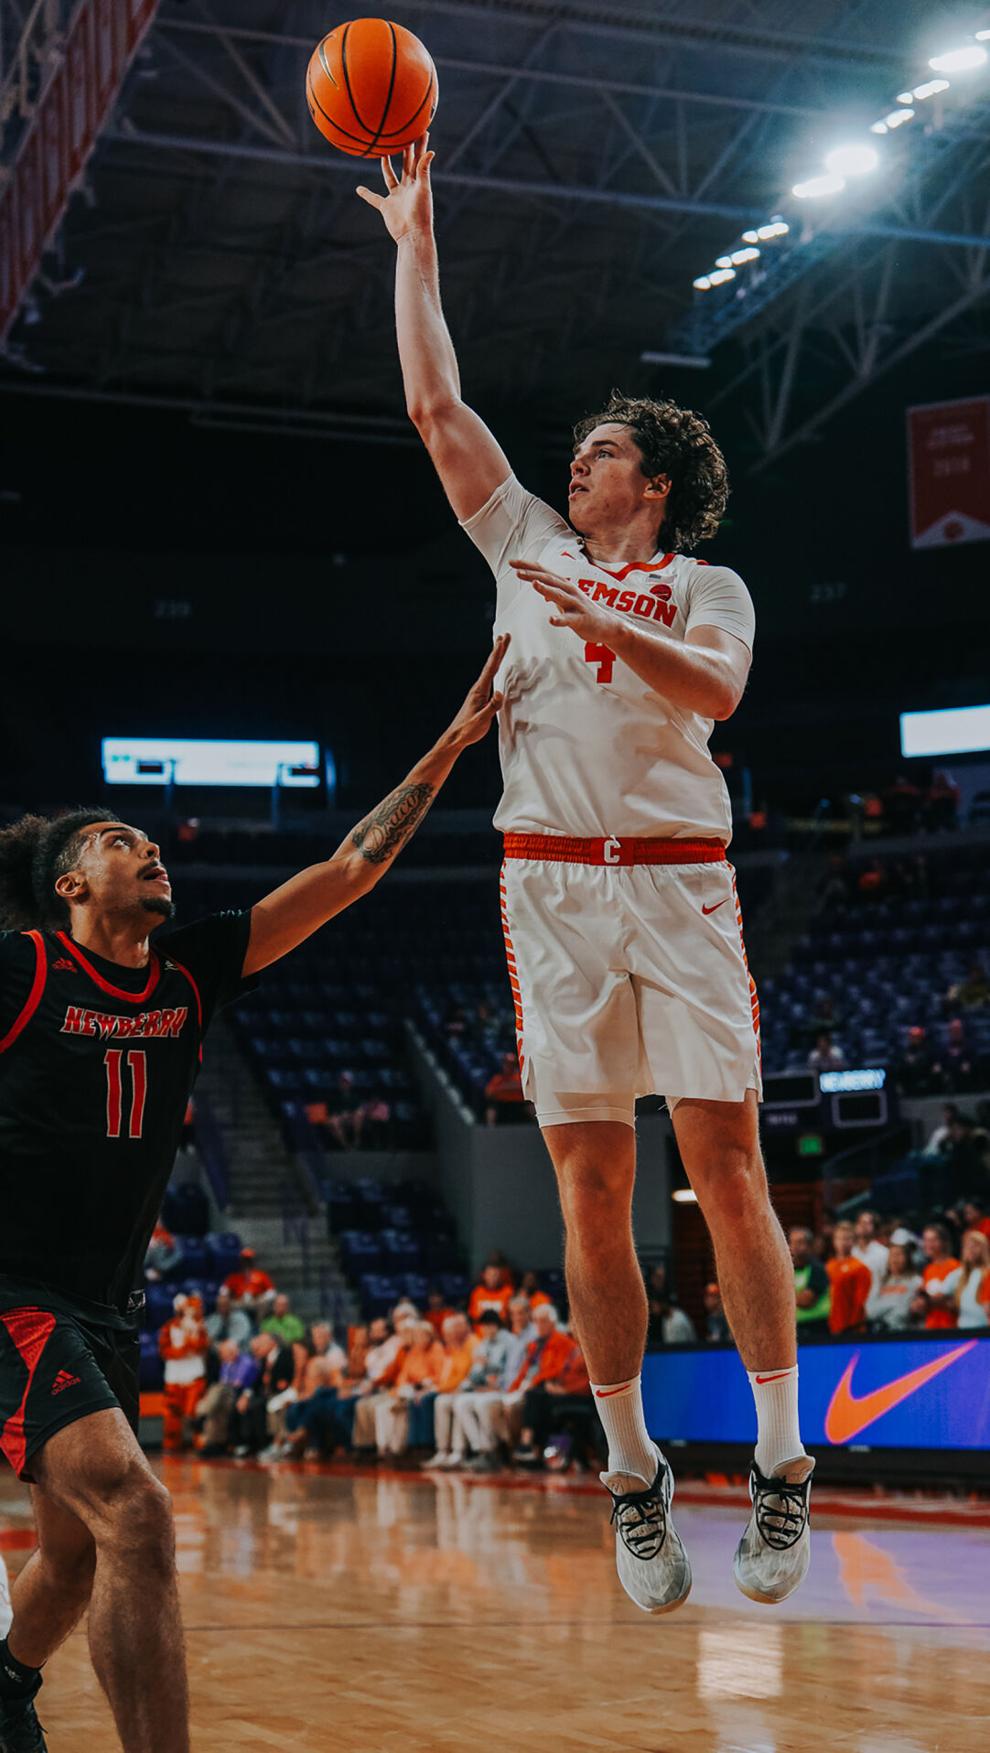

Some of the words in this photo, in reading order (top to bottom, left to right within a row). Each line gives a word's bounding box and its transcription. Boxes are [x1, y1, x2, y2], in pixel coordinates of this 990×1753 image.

[576, 578, 678, 628] EMSON
[584, 641, 617, 683] 4
[604, 840, 621, 863] C
[60, 1005, 188, 1040] NEWBERRY
[103, 1049, 148, 1139] 11
[51, 1377, 81, 1395] adidas
